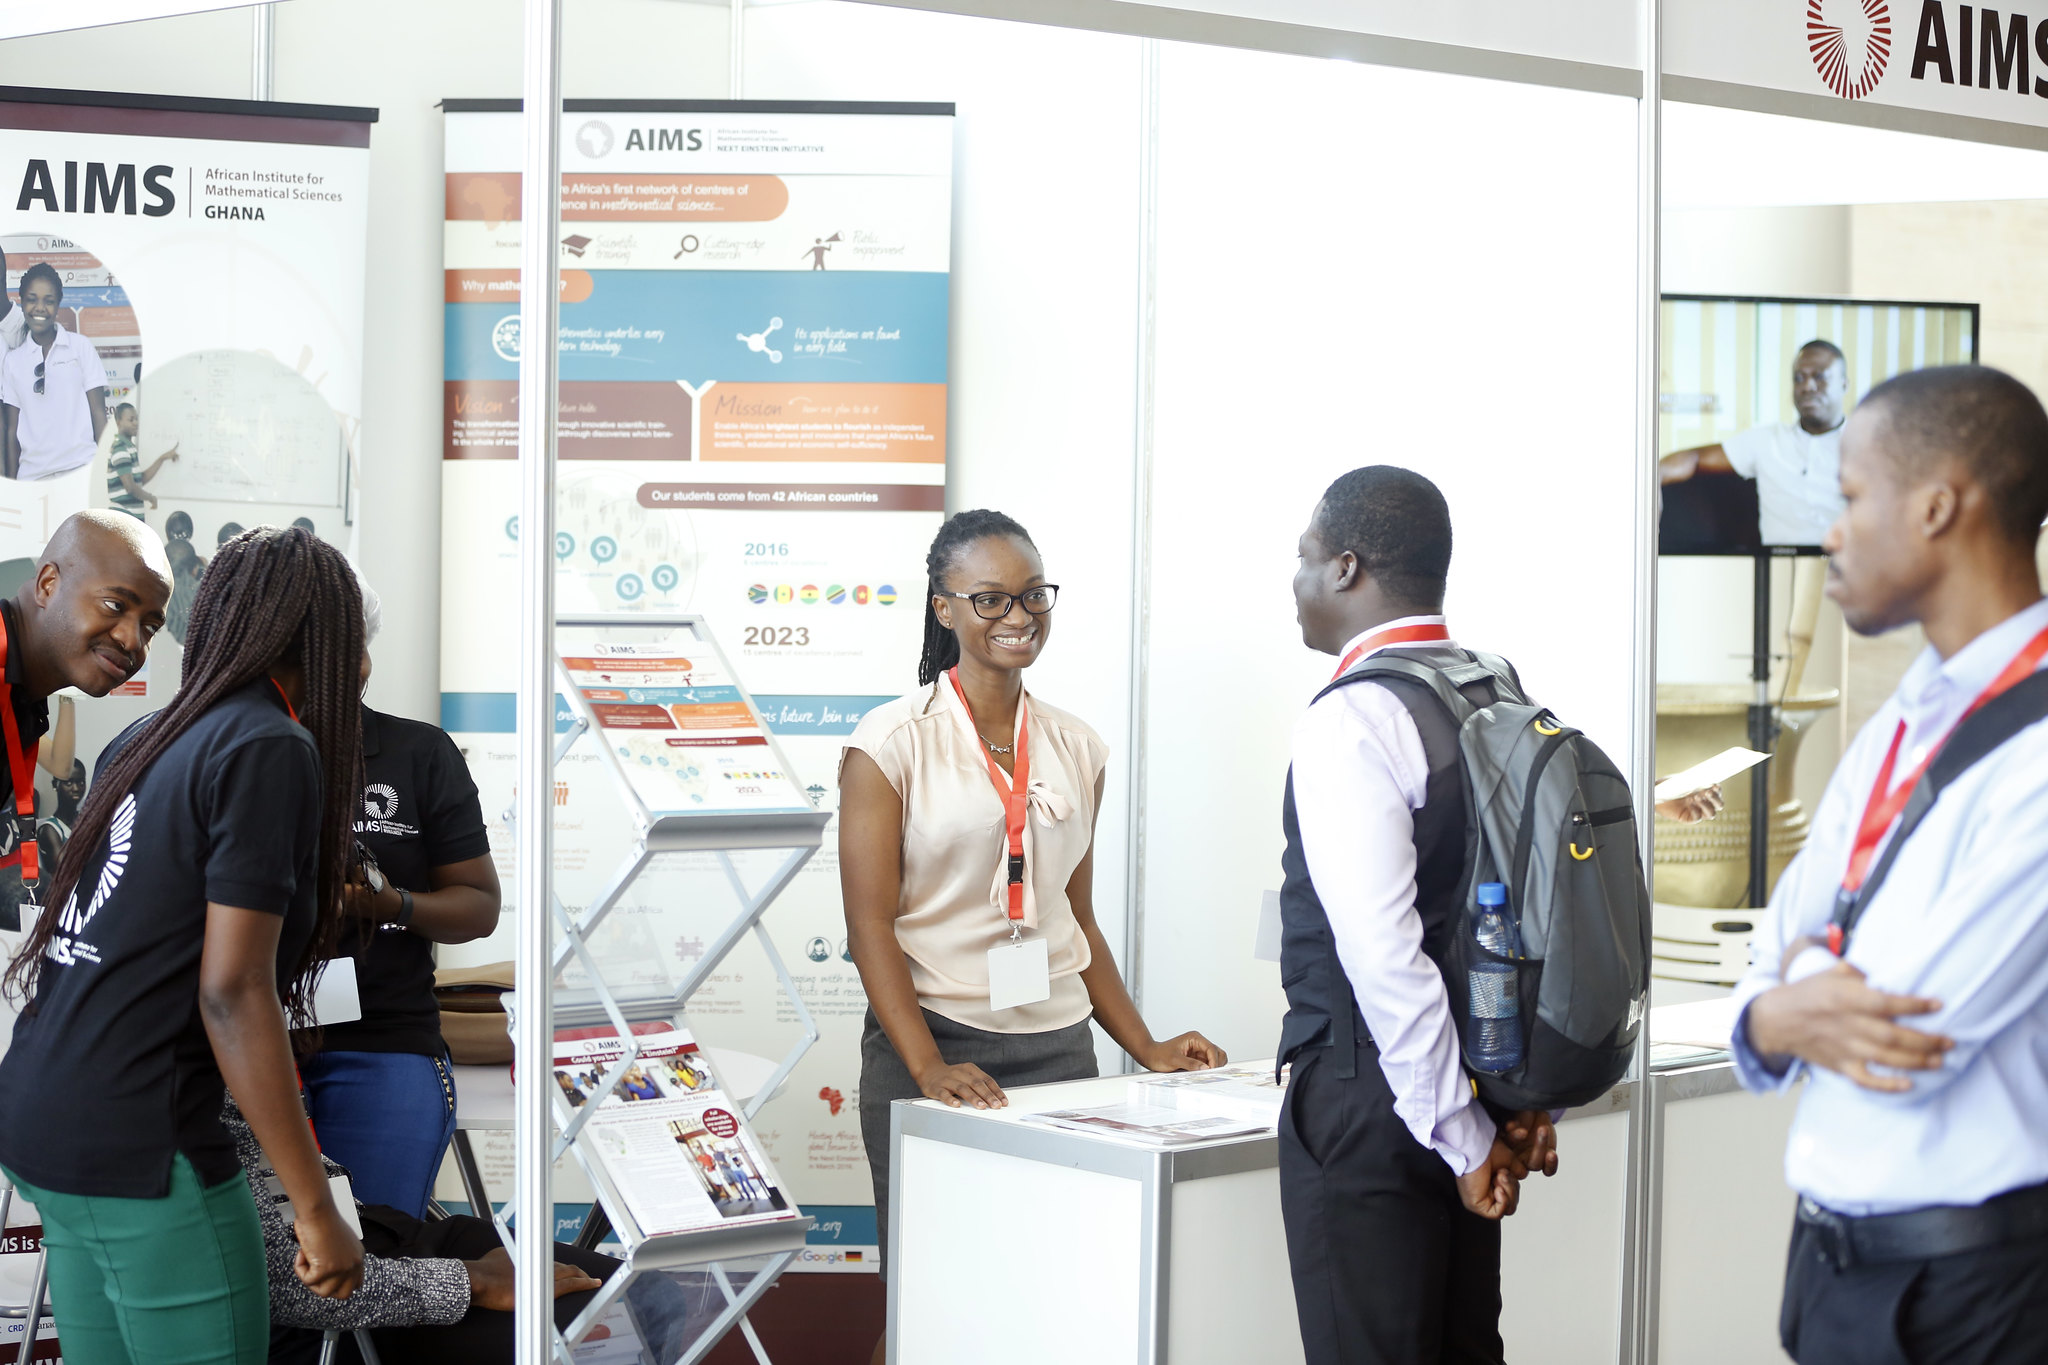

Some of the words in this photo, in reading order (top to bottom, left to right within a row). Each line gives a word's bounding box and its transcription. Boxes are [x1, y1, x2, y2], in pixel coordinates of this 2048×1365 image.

[625, 129, 702, 151] AIMS
[206, 168, 249, 181] African
[253, 171, 304, 184] Institute
[307, 173, 324, 185] for
[16, 159, 176, 217] AIMS
[205, 185, 290, 199] Mathematical
[293, 188, 343, 202] Sciences
[571, 183, 610, 195] Africa's
[613, 183, 633, 194] first
[637, 183, 679, 194] network
[681, 183, 693, 194] of
[695, 185, 735, 195] centres
[738, 184, 749, 195] of
[590, 200, 600, 210] in
[602, 196, 675, 211] mathematical
[205, 206, 265, 221] GHANA
[461, 280, 486, 294] Why
[810, 326, 859, 345] applications
[454, 394, 503, 415] Vision
[714, 393, 784, 418] Mission
[652, 490, 671, 502] Our
[673, 489, 715, 502] students
[717, 492, 745, 502] come
[747, 490, 770, 502] from
[772, 489, 786, 502] 42
[787, 489, 826, 502] African
[828, 491, 879, 503] countries
[745, 543, 790, 557] 2016
[744, 626, 811, 646] 2023
[610, 645, 636, 654] AIMS
[817, 706, 843, 727] Join
[598, 1041, 621, 1050] AIMS
[556, 1216, 582, 1238] part
[22, 1235, 35, 1250] is
[802, 1250, 844, 1265] Google
